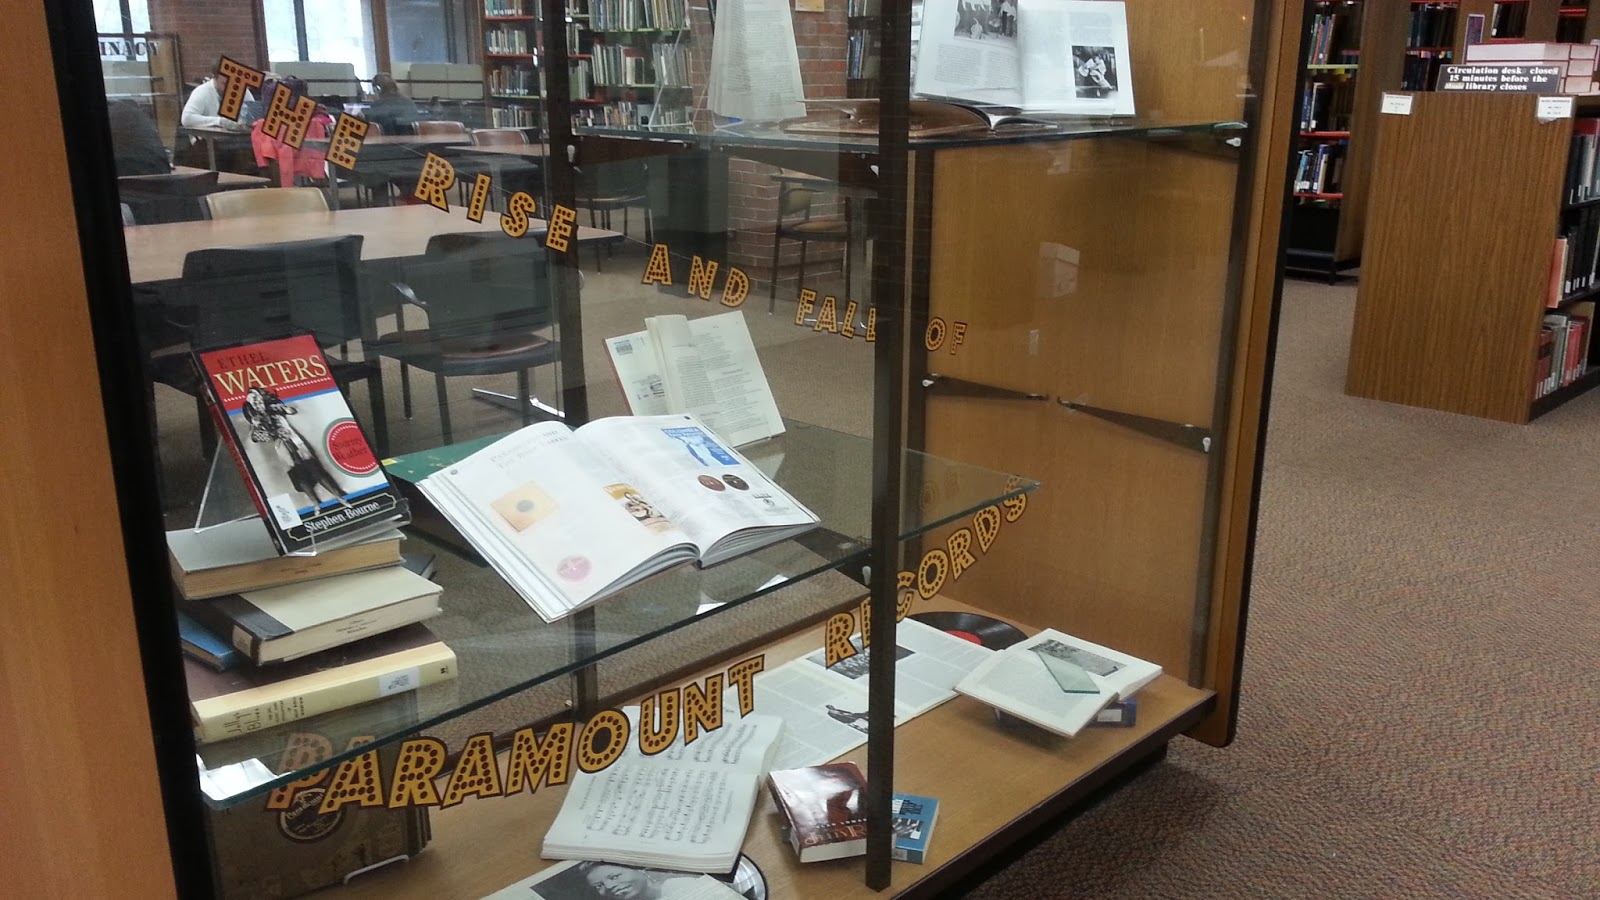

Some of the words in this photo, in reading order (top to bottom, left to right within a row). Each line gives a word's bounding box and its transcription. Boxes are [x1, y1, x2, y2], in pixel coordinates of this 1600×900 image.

[99, 40, 160, 56] INACY
[1447, 66, 1499, 75] Circulation
[1529, 67, 1559, 76] closes
[1449, 74, 1460, 82] 15
[1462, 74, 1498, 82] minutes
[1501, 74, 1530, 82] before
[1532, 75, 1548, 83] the
[1465, 82, 1497, 91] library
[1499, 82, 1528, 91] closes
[217, 55, 370, 170] THE
[414, 151, 577, 253] RISE
[641, 243, 750, 307] AND
[924, 315, 968, 356] OF
[213, 355, 327, 395] WATERS
[303, 513, 347, 534] Stephen
[344, 501, 380, 520] Bourne
[267, 653, 765, 814] PARAMOUNT
